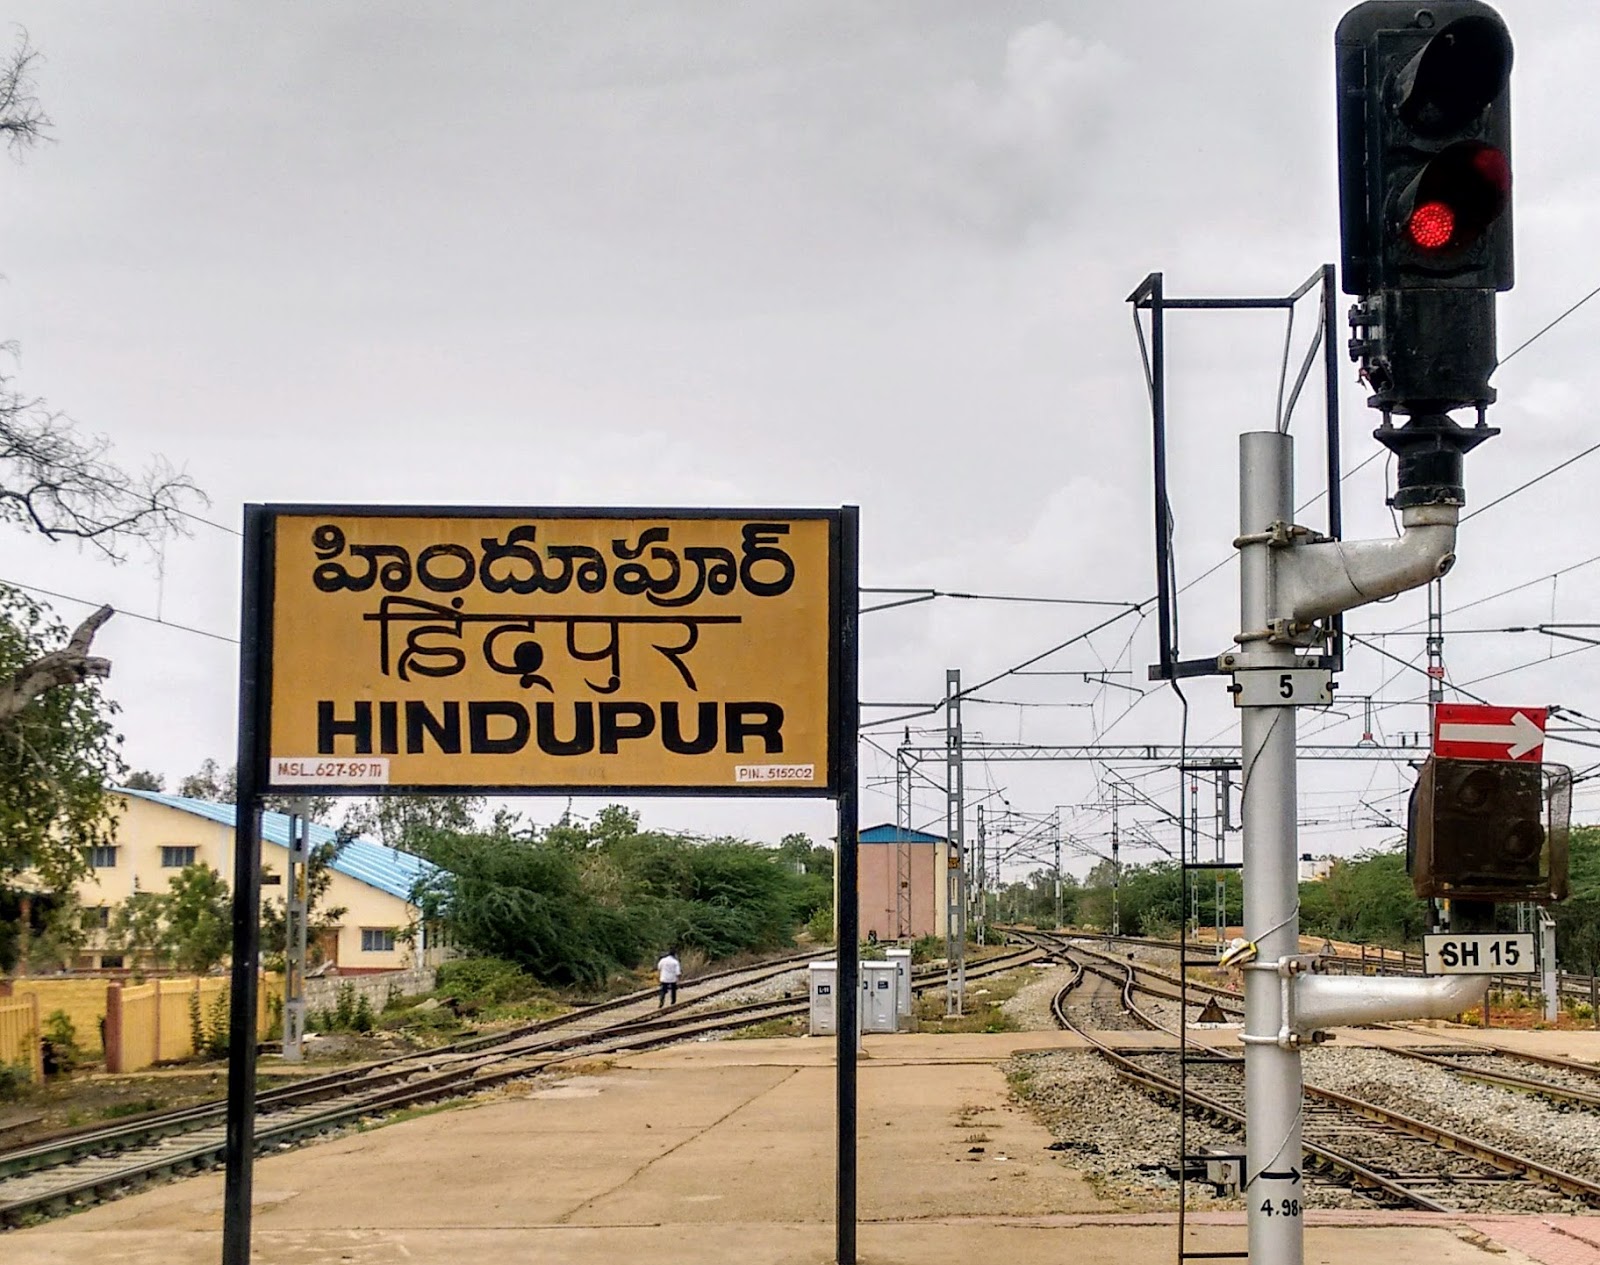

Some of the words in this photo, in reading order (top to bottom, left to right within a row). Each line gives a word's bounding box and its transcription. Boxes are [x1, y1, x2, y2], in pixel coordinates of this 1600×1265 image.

[311, 523, 796, 607] హిందూపూర్
[1280, 674, 1293, 699] 5
[317, 701, 785, 756] HINDUPUR
[767, 768, 812, 779] 515202
[1442, 941, 1479, 967] SH
[1489, 940, 1520, 966] 15
[1260, 1198, 1299, 1217] 4.98
